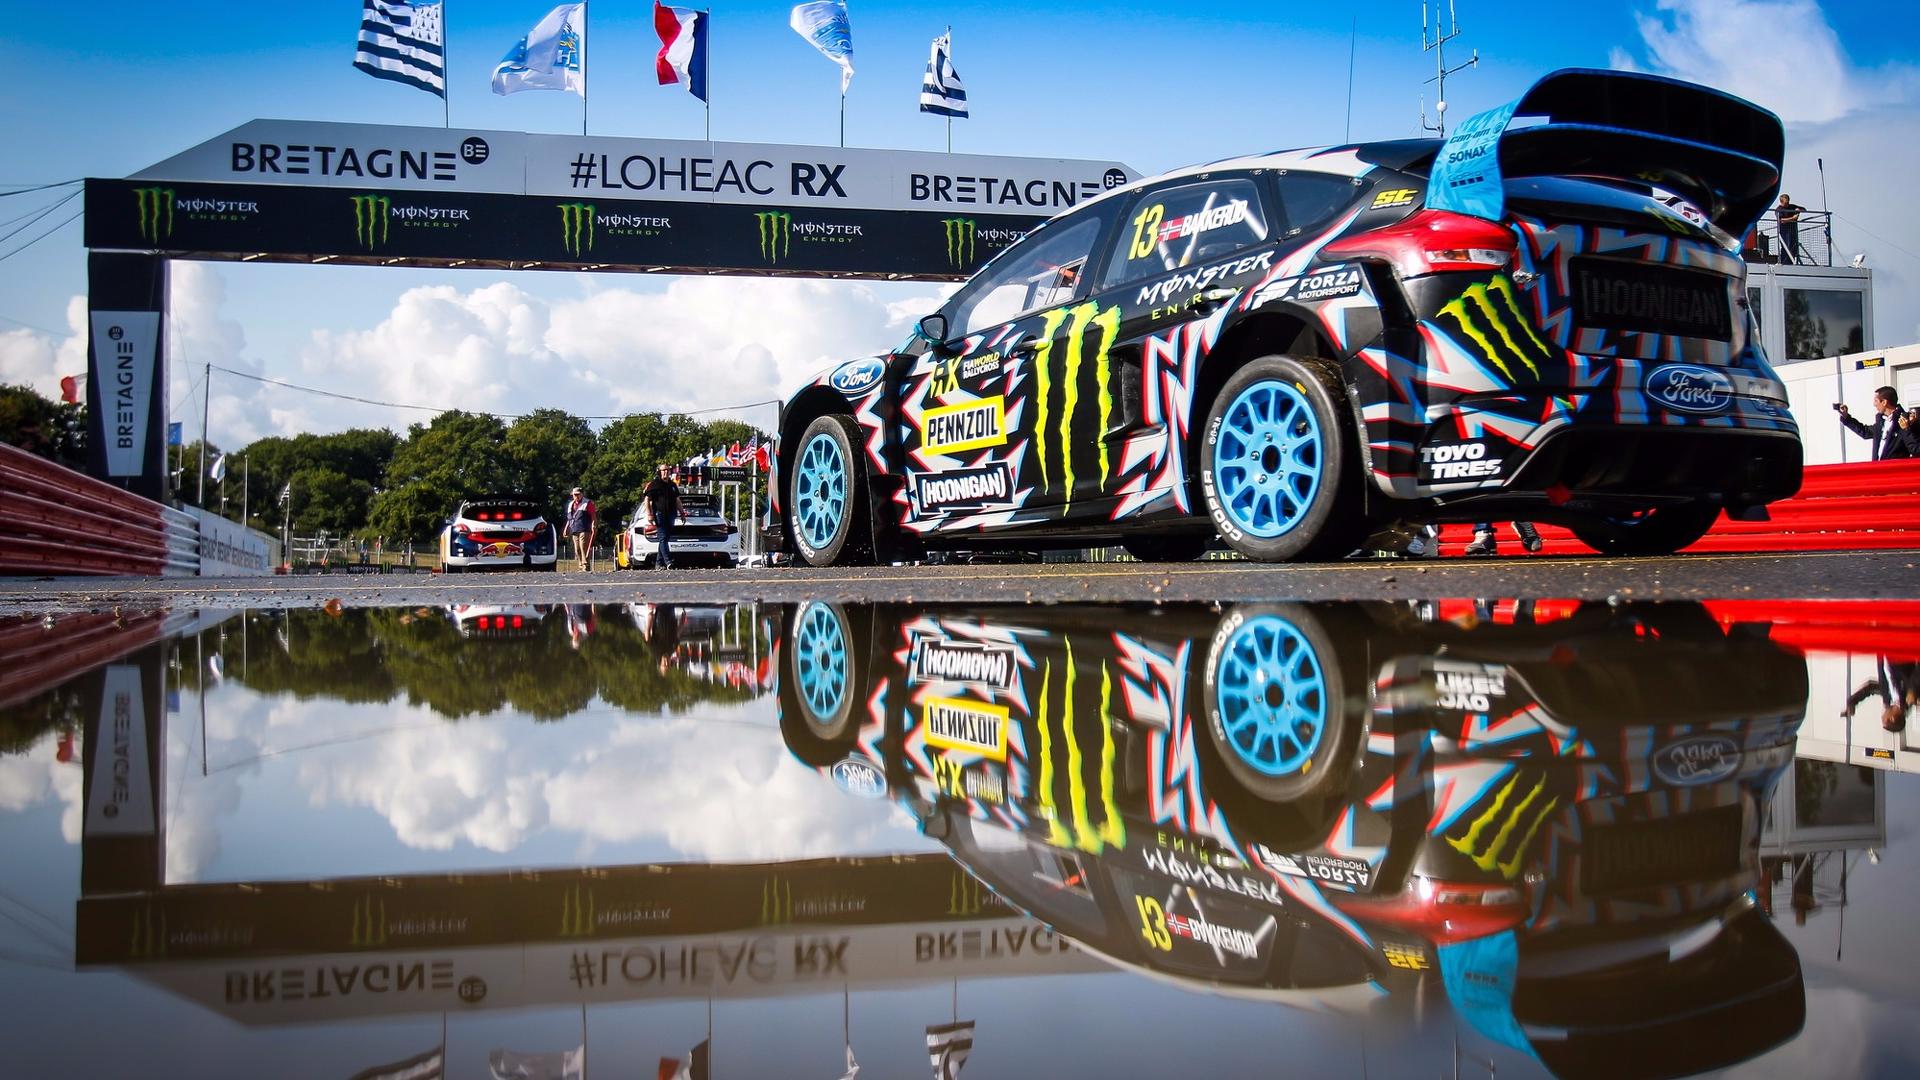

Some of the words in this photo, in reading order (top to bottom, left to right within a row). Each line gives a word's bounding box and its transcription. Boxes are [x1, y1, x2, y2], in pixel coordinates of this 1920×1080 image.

[232, 143, 457, 180] BRETAGNE
[1448, 144, 1487, 164] SONAX
[571, 153, 774, 195] #LOHEAC
[791, 163, 848, 197] RX
[911, 174, 1099, 207] BRETAGNE
[177, 199, 259, 213] MONSTER
[392, 205, 471, 220] MONSTER
[190, 213, 248, 221] ENERGY
[597, 214, 671, 228] MONSTER
[793, 222, 863, 236] MONSTER
[977, 228, 1027, 241] MONST
[1128, 204, 1165, 260] 13
[1136, 251, 1275, 305] MONSTER
[1299, 270, 1360, 291] FORZA
[1297, 284, 1360, 300] MOTORSPORT
[840, 364, 873, 388] Ford
[963, 361, 1000, 380] RALLYCROSS
[117, 342, 133, 448] BRETAGNE
[1663, 370, 1718, 404] Ford
[928, 406, 998, 447] PENNZOIL
[1420, 443, 1485, 463] TOYO
[1431, 459, 1502, 479] TIRES
[1203, 470, 1243, 541] COOPER
